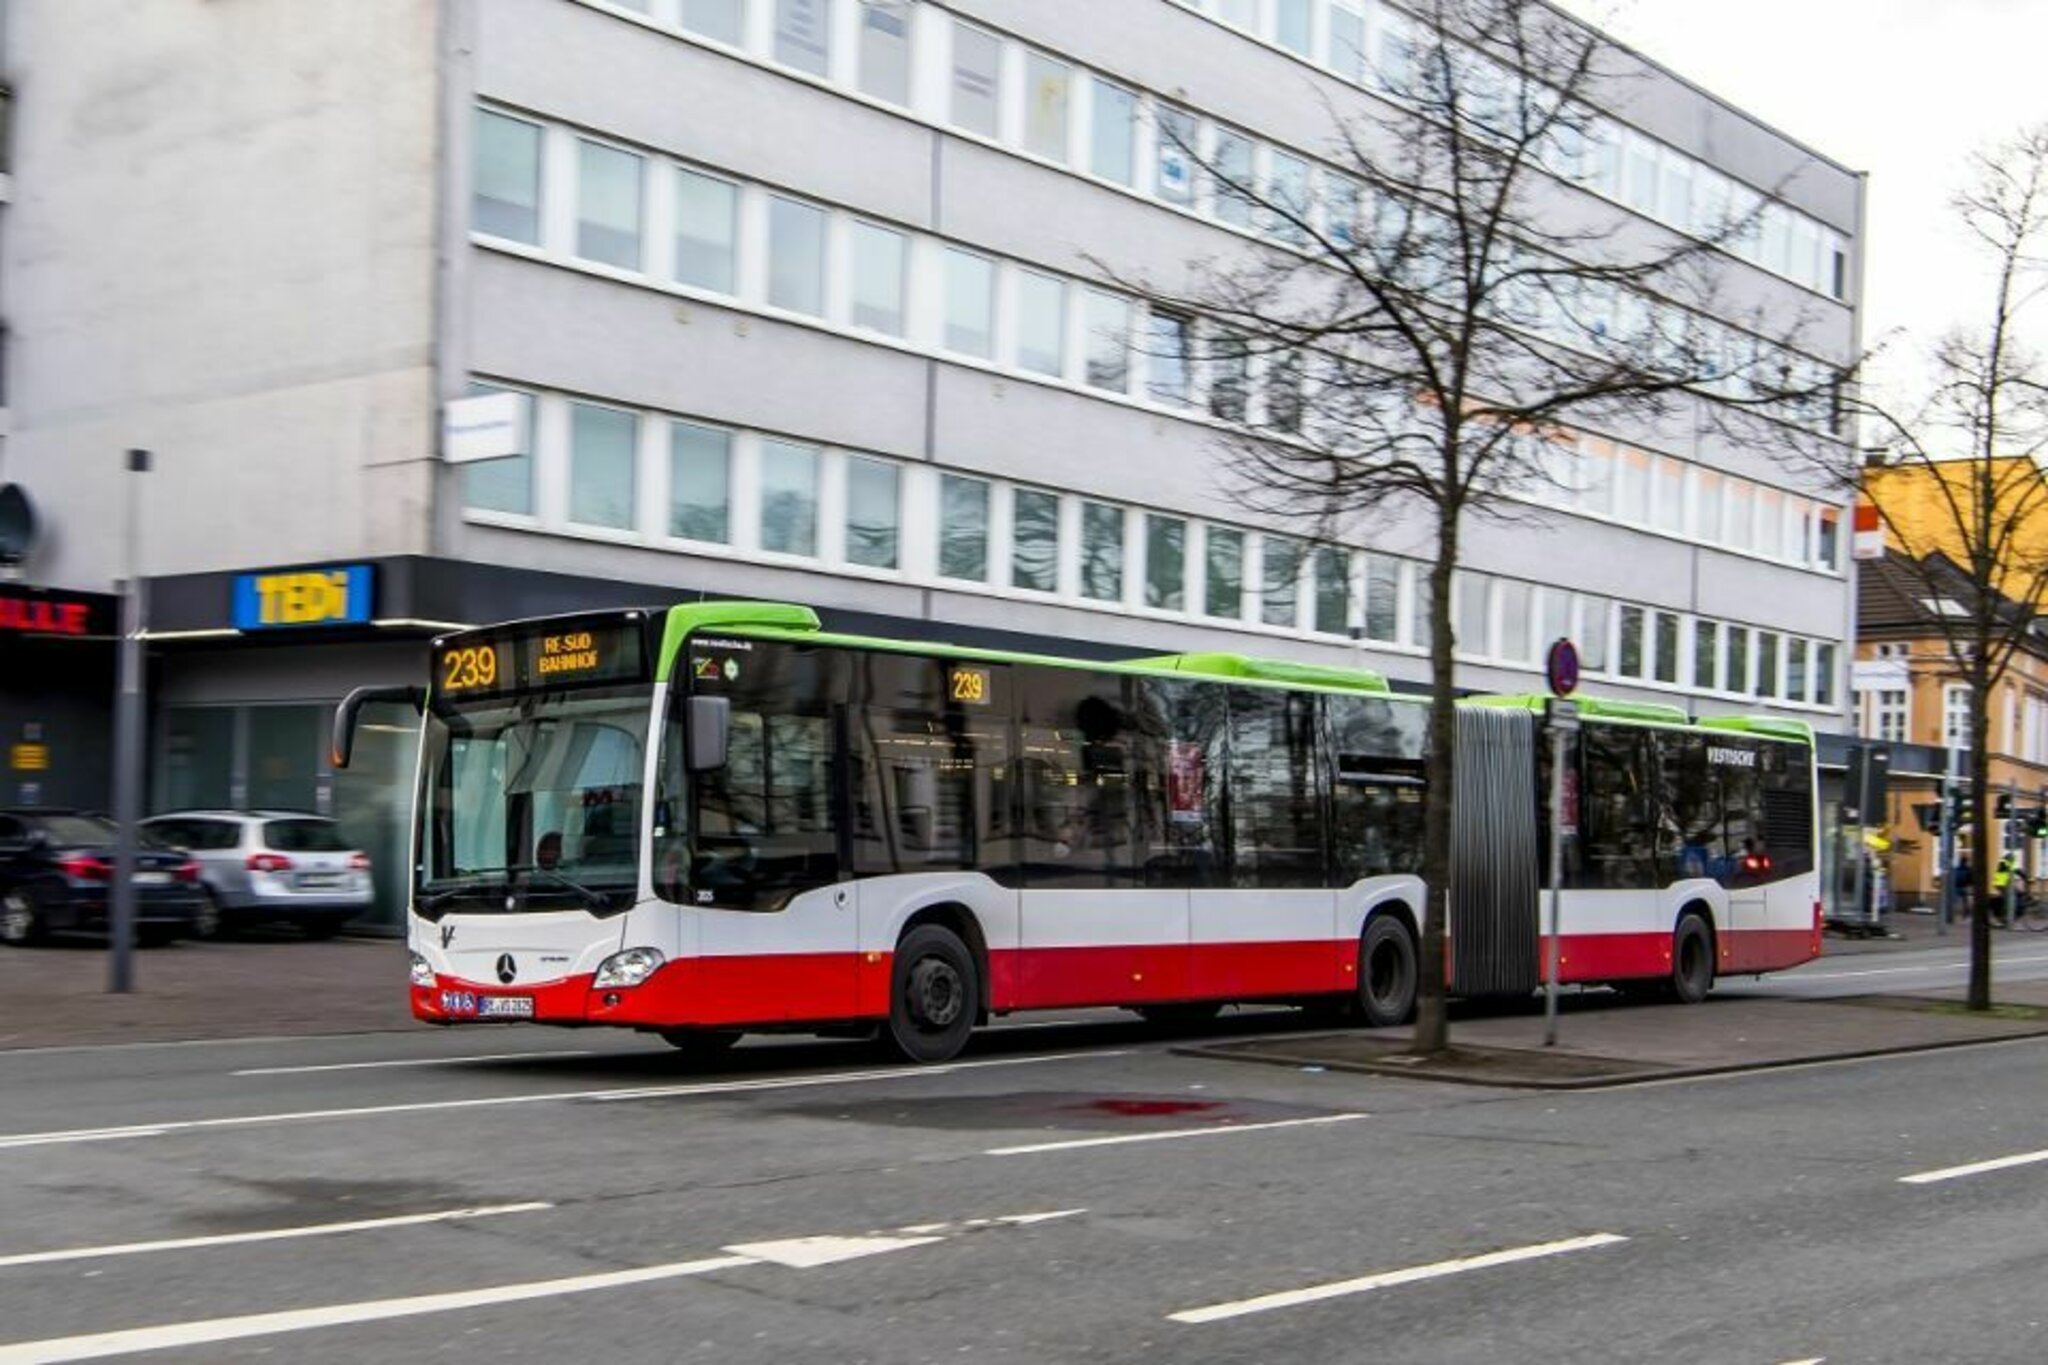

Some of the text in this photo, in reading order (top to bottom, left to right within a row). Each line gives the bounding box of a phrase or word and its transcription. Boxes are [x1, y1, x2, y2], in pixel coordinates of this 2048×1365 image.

[257, 572, 347, 623] TEDi
[444, 647, 496, 689] 239
[539, 652, 598, 673] BAHNHOF
[953, 671, 982, 699] 239
